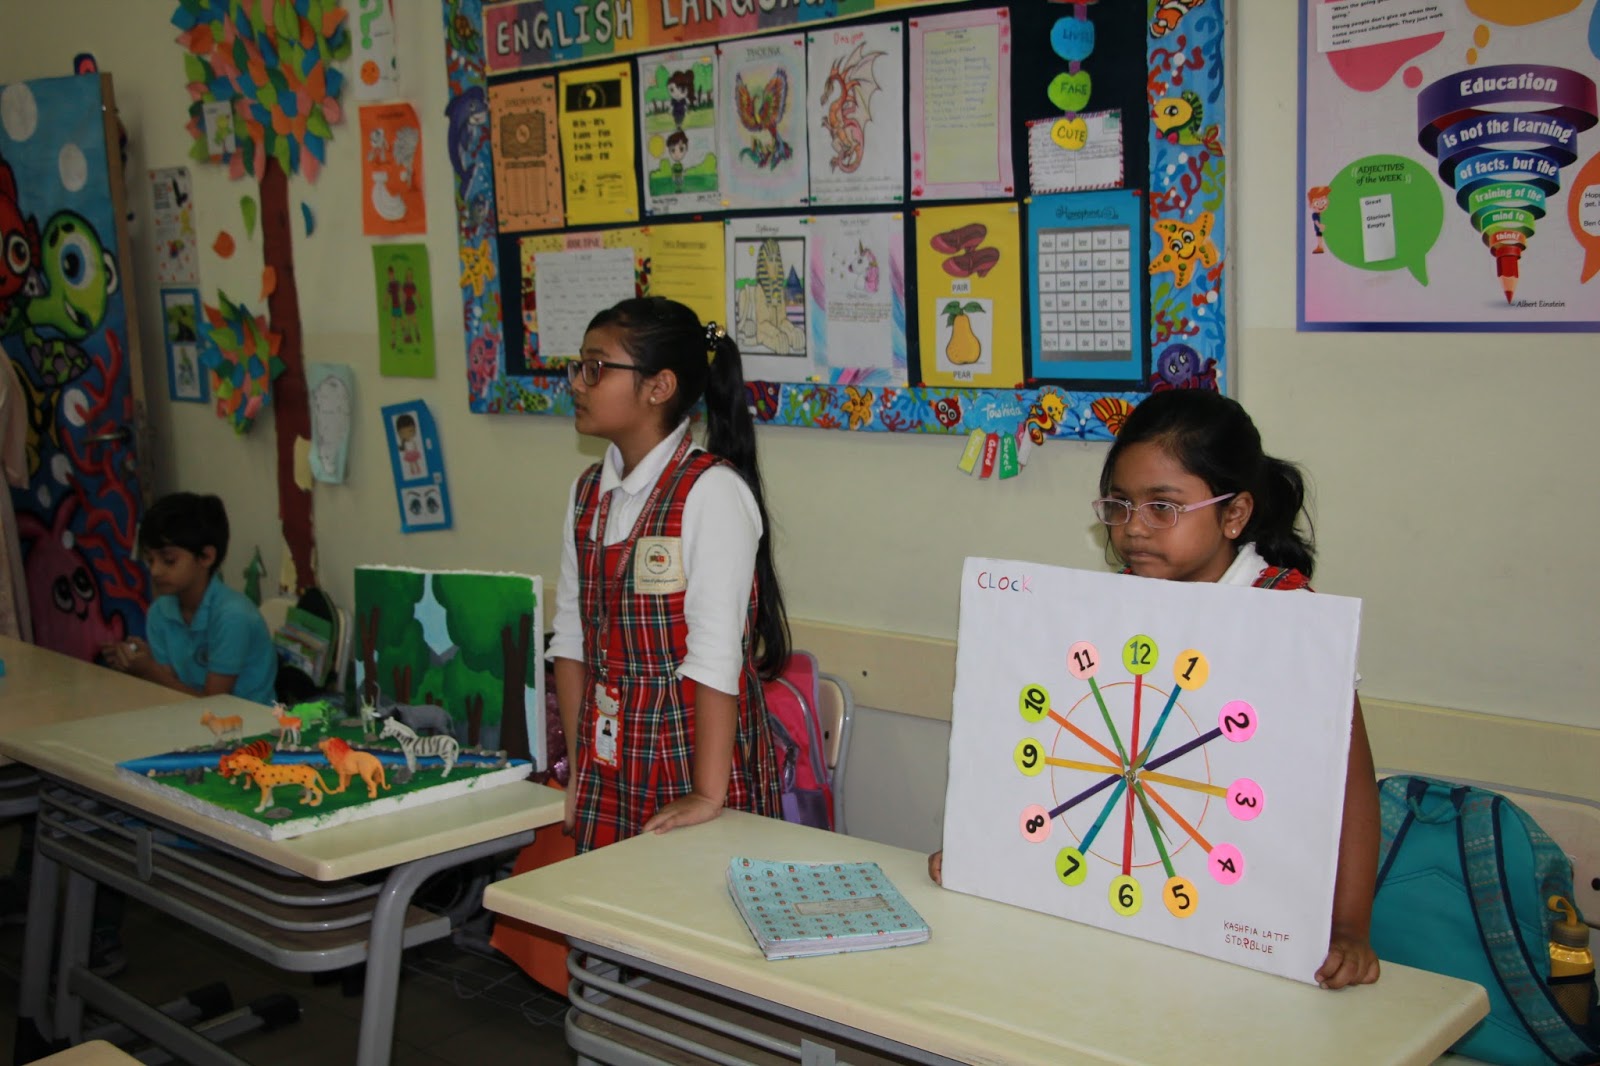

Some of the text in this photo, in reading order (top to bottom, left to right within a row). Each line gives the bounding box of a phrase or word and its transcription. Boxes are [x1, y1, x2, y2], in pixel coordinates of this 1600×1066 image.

[496, 0, 634, 54] ENGLISH
[1332, 22, 1350, 30] Strong
[1351, 19, 1370, 27] people
[1402, 17, 1416, 25] They
[1417, 15, 1428, 23] just
[1460, 72, 1558, 97] Education
[1056, 125, 1086, 143] CUTE
[1442, 117, 1574, 149] is not the learning
[1357, 163, 1405, 176] ADJECTIVES
[1460, 164, 1474, 179] of
[1512, 156, 1535, 169] but
[1536, 160, 1557, 176] the
[1356, 174, 1364, 186] of
[1366, 176, 1376, 184] the
[1475, 187, 1542, 202] training of the
[1366, 213, 1391, 221] Glorious
[1492, 211, 1525, 221] mind to
[1496, 232, 1520, 241] think!
[952, 283, 968, 292] PAIR
[953, 370, 971, 379] PEAR
[977, 571, 1033, 594] CLOCK
[1073, 649, 1095, 672] 11
[1130, 641, 1151, 665] 12
[1182, 656, 1199, 681] 1
[1024, 688, 1046, 714] 10
[1224, 712, 1250, 732] 2
[1022, 744, 1038, 769] 9
[1234, 791, 1257, 809] 3
[1025, 815, 1045, 833] 8
[1063, 855, 1080, 877] 7
[1217, 857, 1236, 874] 4
[1118, 884, 1134, 907] 6
[1173, 884, 1190, 910] 5
[1224, 920, 1290, 942] KASHFIA LATIF
